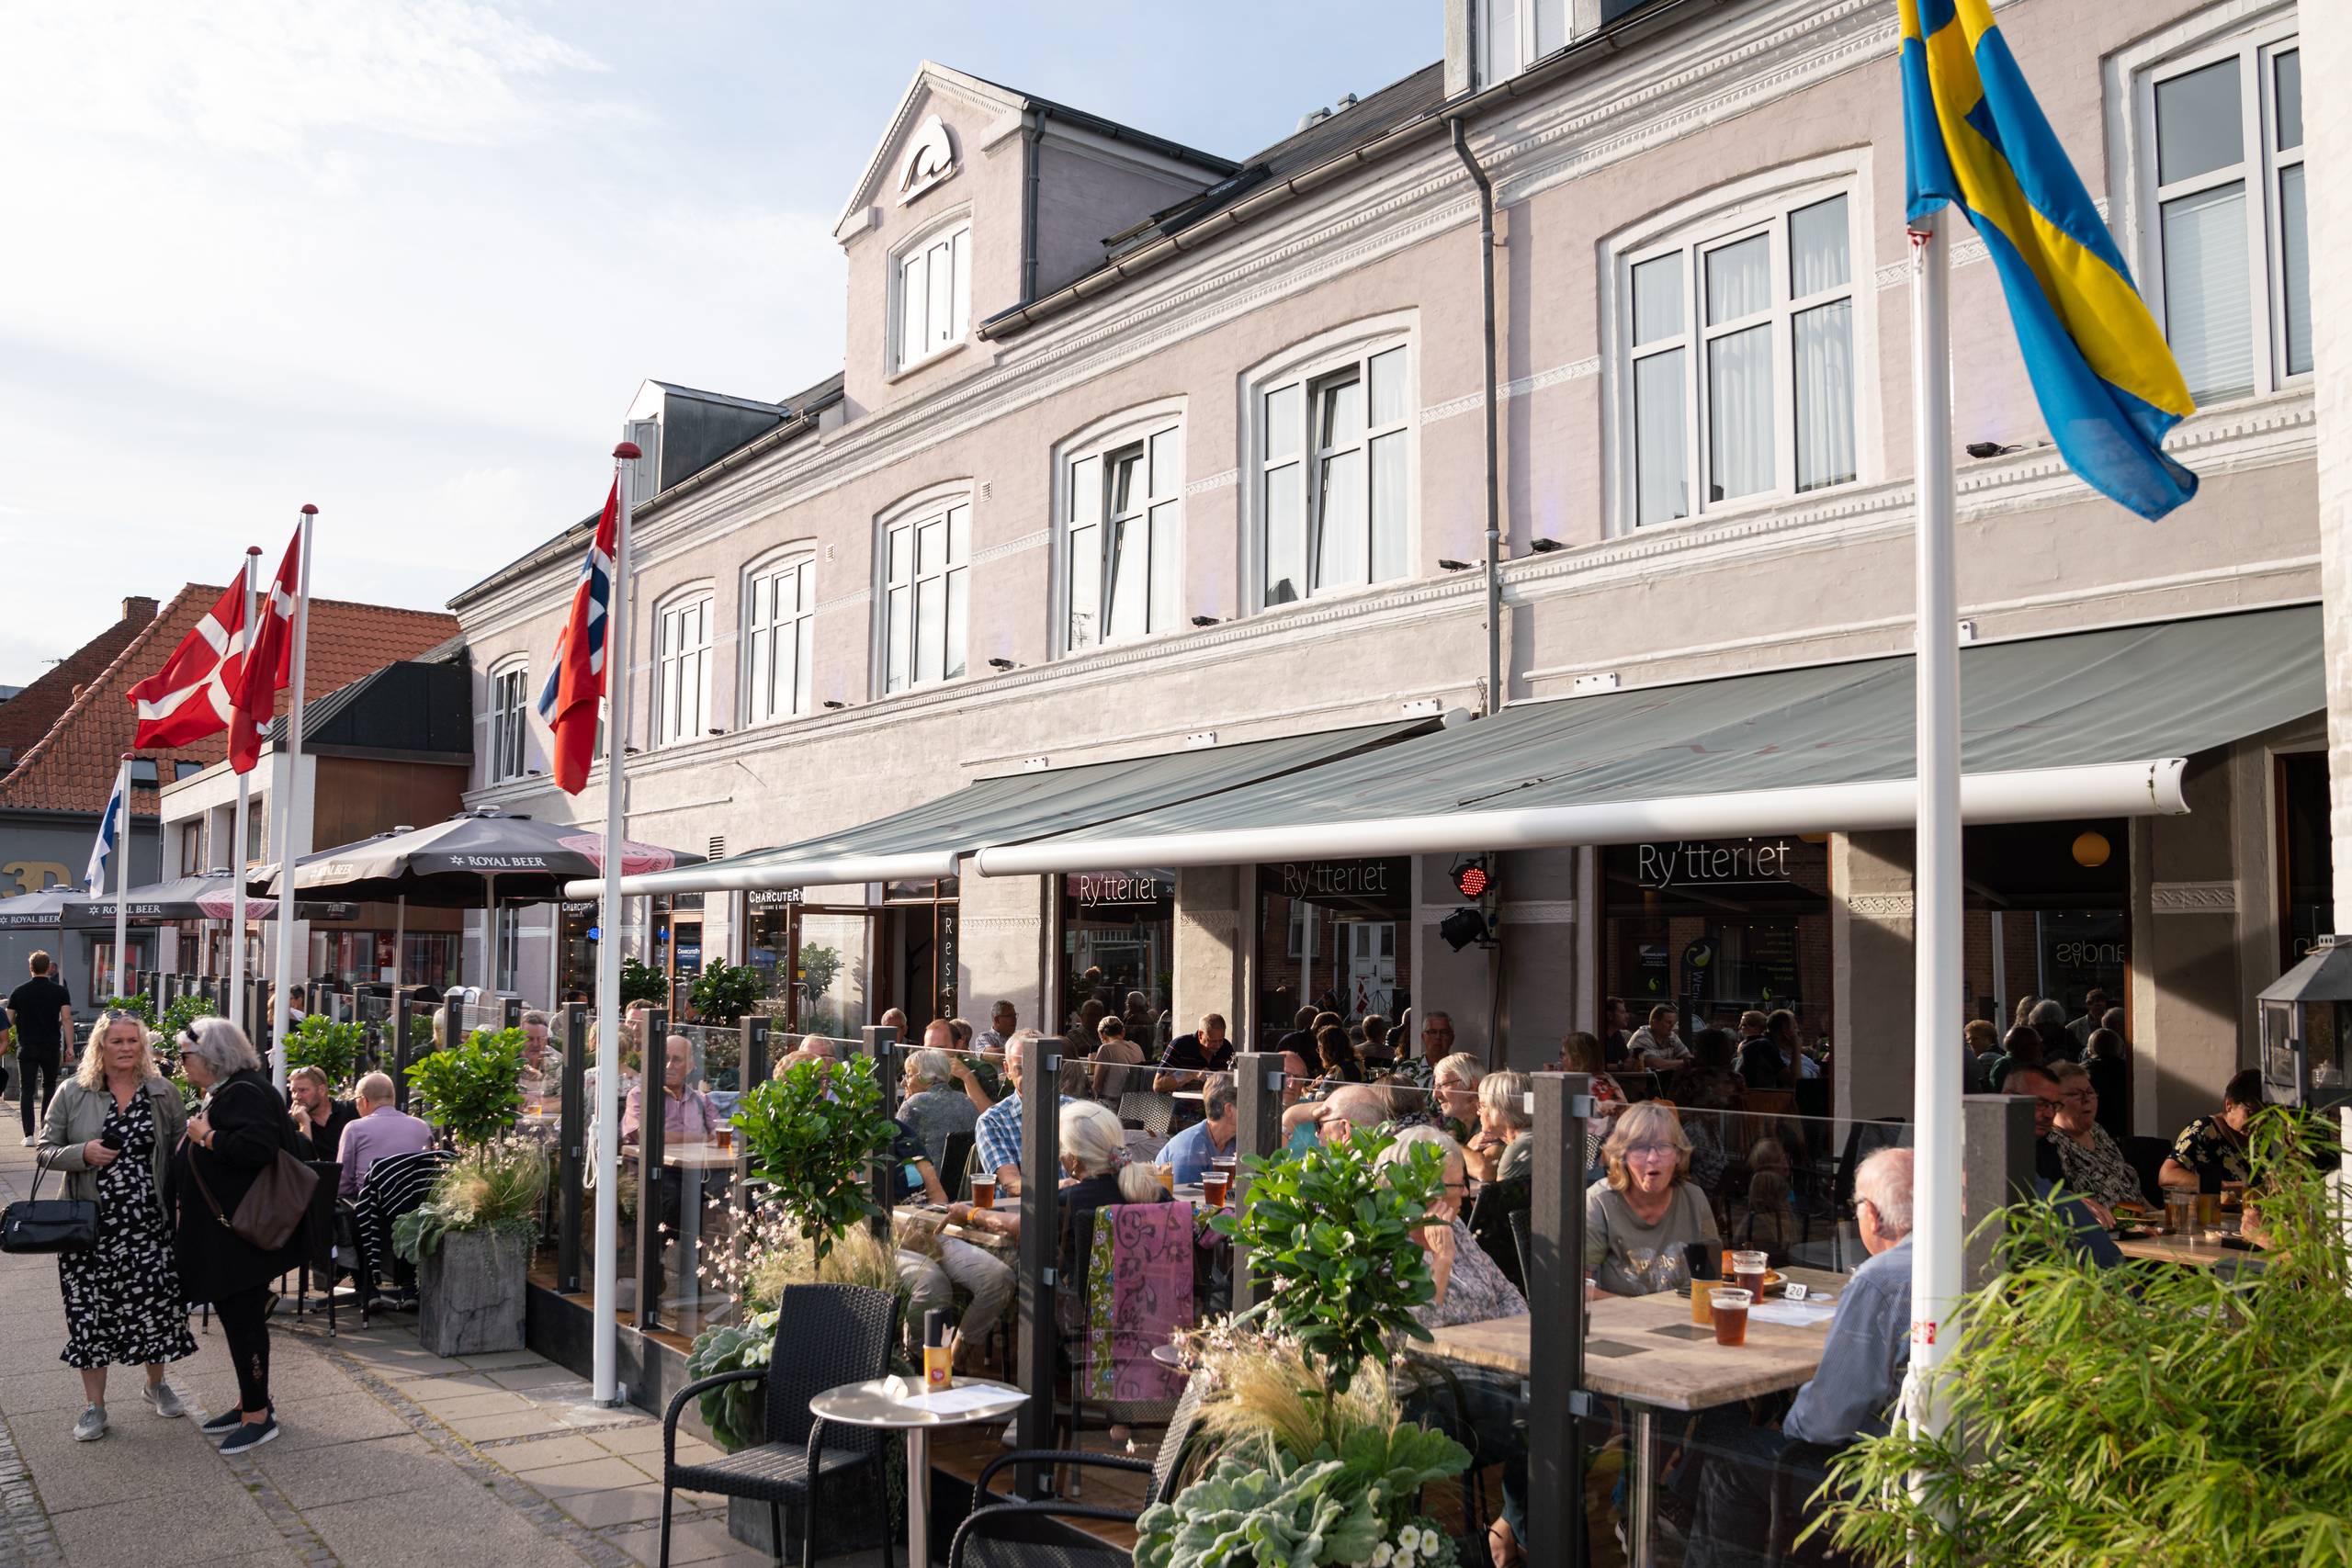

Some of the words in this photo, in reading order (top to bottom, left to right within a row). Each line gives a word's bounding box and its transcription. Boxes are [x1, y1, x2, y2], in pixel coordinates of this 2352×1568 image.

[468, 856, 511, 866] ROYAL
[511, 857, 547, 866] BEER
[1639, 838, 1791, 888] Ry'tteriet
[2, 861, 73, 898] 3D
[1080, 871, 1158, 908] Ry'tteriet
[1284, 859, 1387, 901] Ry'tteriet
[11, 916, 37, 924] ROYAL
[39, 915, 61, 923] BEER
[102, 905, 134, 914] ROL
[135, 905, 162, 914] BEER
[1789, 1286, 1804, 1296] 20
